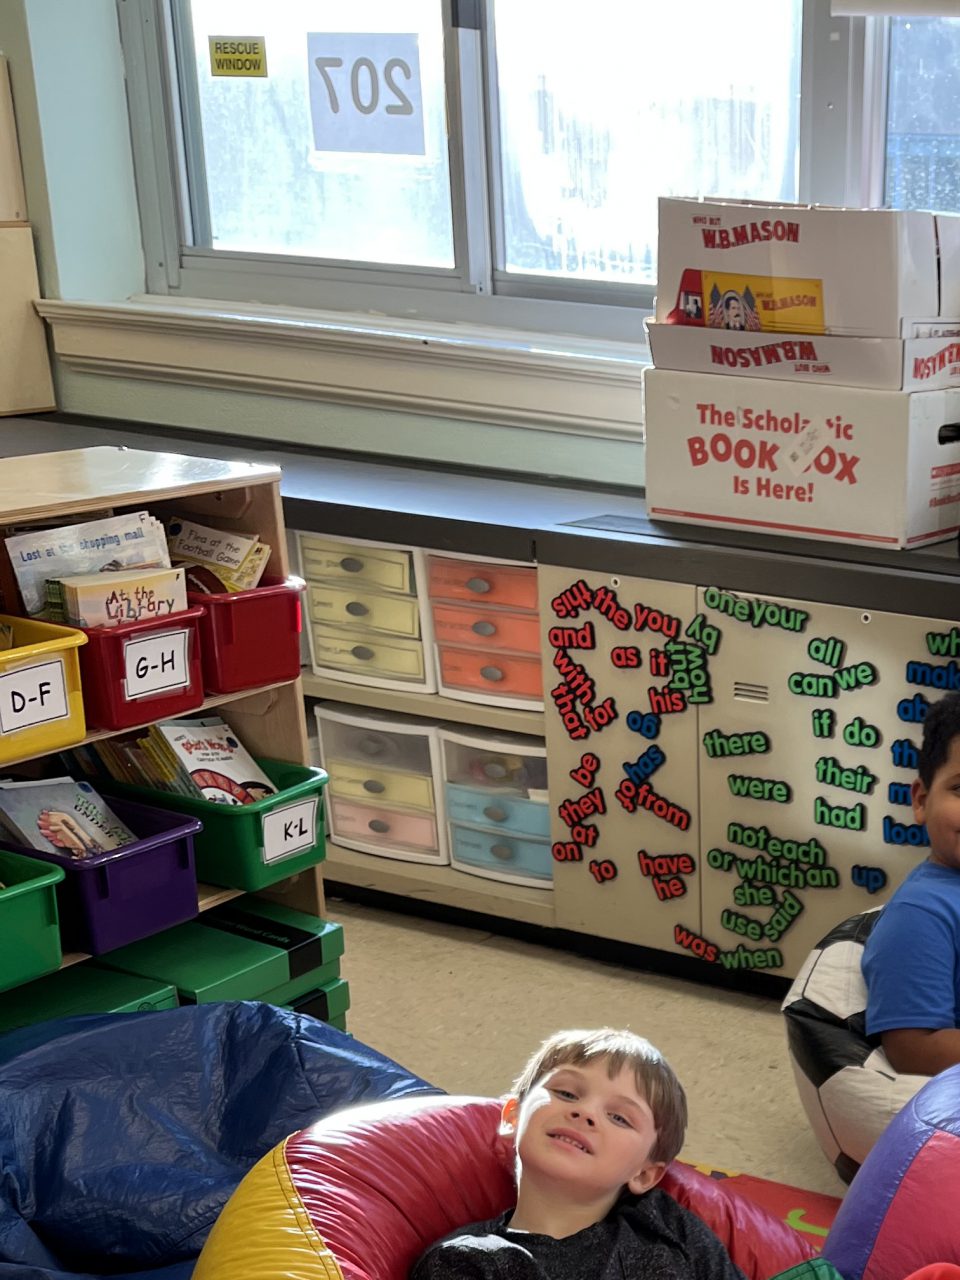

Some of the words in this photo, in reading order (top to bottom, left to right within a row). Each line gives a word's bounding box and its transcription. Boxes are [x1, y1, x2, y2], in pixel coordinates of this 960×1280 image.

[214, 41, 259, 57] RESCUE
[215, 57, 262, 72] WINDOW
[702, 219, 800, 250] W.B.MASON
[696, 403, 735, 428] The
[687, 432, 780, 472] BOOK
[801, 445, 860, 485] OX
[733, 475, 750, 495] Is
[756, 477, 815, 503] Here!
[20, 548, 42, 562] Lost
[45, 547, 56, 558] at
[79, 533, 121, 551] shopping
[124, 526, 145, 541] mall
[178, 538, 215, 559] Football
[216, 551, 241, 566] Game
[188, 529, 208, 544] Flea
[209, 539, 221, 548] at
[225, 542, 241, 554] the
[105, 598, 176, 622] Library
[107, 590, 128, 605] At
[134, 586, 155, 604] the
[551, 579, 593, 618] this
[594, 586, 631, 630] the
[704, 586, 750, 621] one
[634, 603, 680, 639] you
[749, 597, 808, 632] your
[549, 621, 595, 649] and
[686, 613, 720, 655] by
[135, 649, 176, 679] G-H
[611, 647, 641, 668] as
[649, 648, 669, 676] it
[665, 639, 690, 691] but
[808, 636, 846, 668] all
[553, 648, 596, 705] with
[686, 642, 713, 704] how
[788, 672, 837, 698] can
[833, 661, 876, 691] we
[11, 681, 52, 714] D-F
[551, 682, 591, 740] that
[648, 686, 687, 714] his
[583, 697, 617, 731] for
[626, 710, 661, 740] go
[811, 709, 835, 738] if
[703, 729, 770, 758] there
[843, 717, 880, 747] do
[570, 752, 601, 788] be
[623, 744, 666, 785] has
[815, 757, 876, 794] their
[615, 778, 637, 813] of
[728, 774, 791, 802] were
[559, 787, 606, 828] they
[636, 782, 691, 831] from
[814, 797, 865, 831] had
[283, 817, 309, 842] K-L
[571, 824, 599, 848] at
[727, 823, 769, 849] not
[552, 842, 583, 862] on
[638, 850, 696, 877] have
[707, 849, 734, 871] or
[768, 838, 827, 866] each
[589, 859, 617, 884] to
[735, 855, 805, 889] which
[806, 867, 840, 889] an
[851, 864, 887, 894] up
[652, 876, 687, 901] he
[733, 882, 776, 906] she
[720, 908, 763, 941] use
[764, 889, 804, 943] said
[674, 924, 721, 962] was
[718, 944, 784, 970] when
